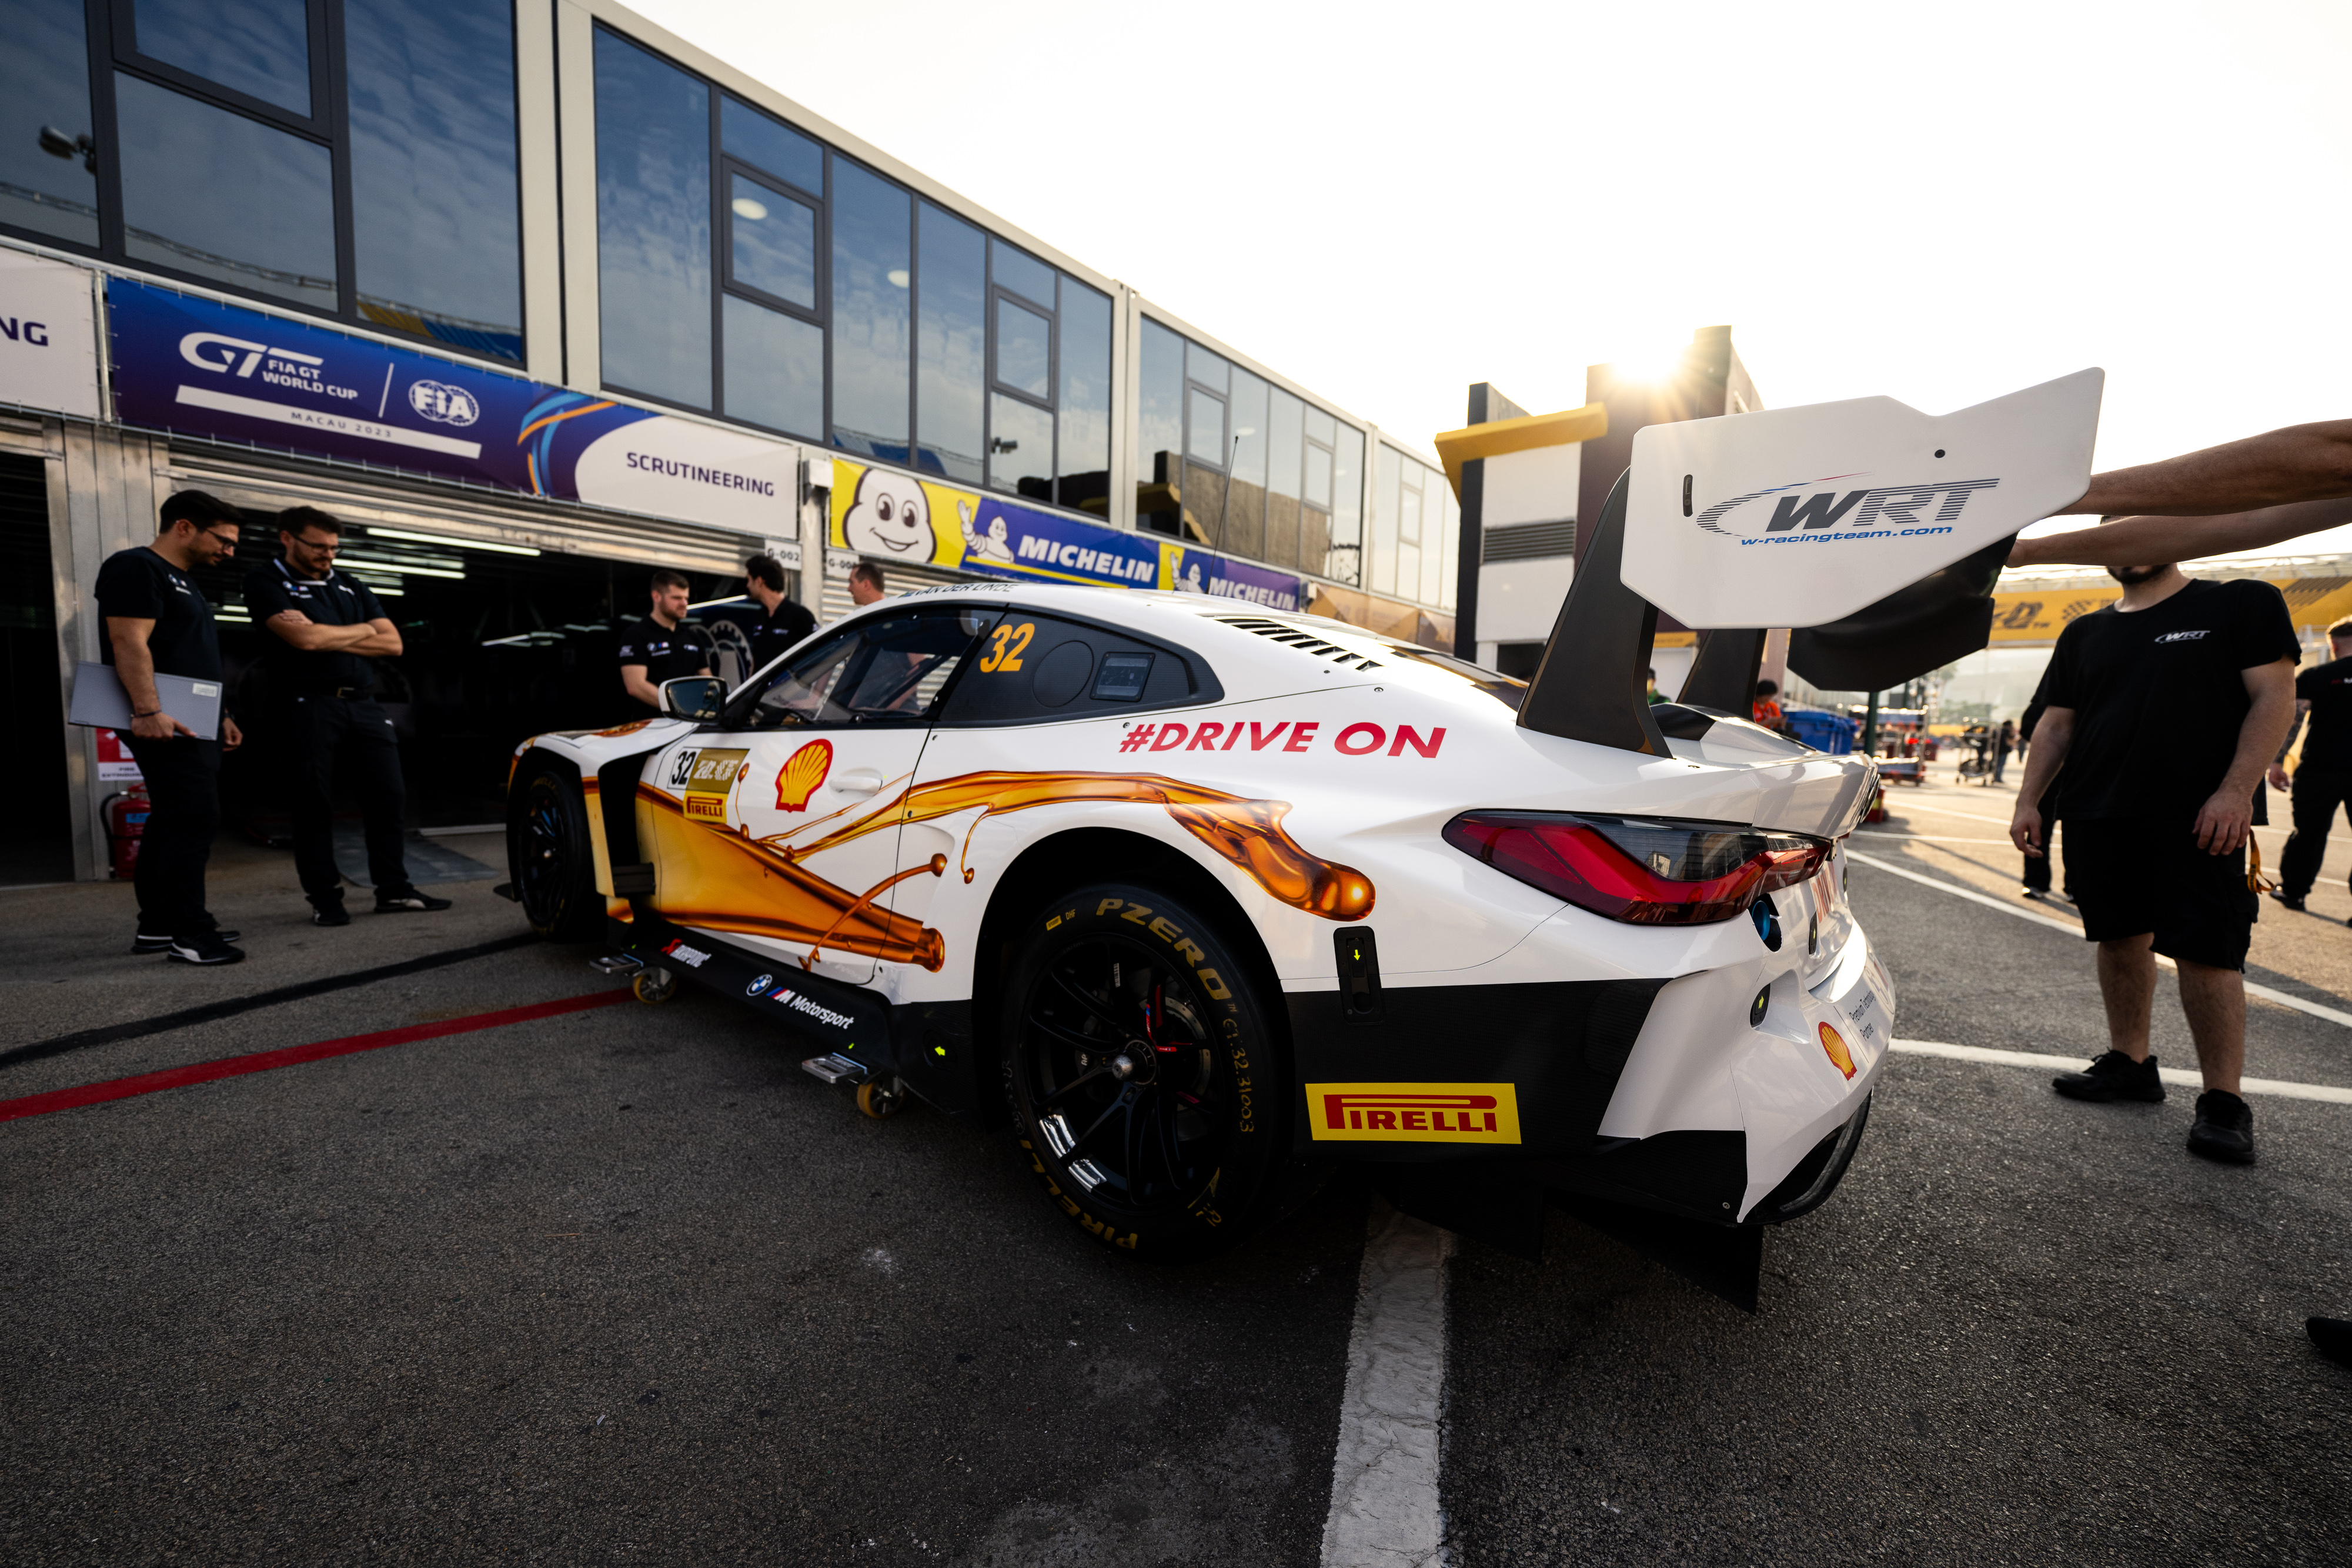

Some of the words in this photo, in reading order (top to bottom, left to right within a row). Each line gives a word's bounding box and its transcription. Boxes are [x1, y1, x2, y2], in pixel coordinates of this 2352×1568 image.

[179, 332, 268, 378] GT
[268, 359, 296, 375] FIA
[299, 366, 321, 380] GT
[262, 370, 324, 393] WORLD
[326, 385, 359, 400] CUP
[291, 412, 346, 430] MACAU
[355, 424, 391, 438] 2023
[626, 452, 774, 497] SCRUTINEERING
[1766, 478, 2000, 533] WRT
[1741, 526, 1953, 546] w-racingteam.com
[1017, 534, 1155, 583] MICHELIN
[942, 584, 973, 592] DER
[972, 583, 1018, 593] LINDE
[1208, 576, 1297, 611] MICHELIN
[980, 623, 1035, 673] 32
[2165, 630, 2211, 641] WRT
[1118, 721, 1319, 753] #DRIVE
[1334, 721, 1446, 758] ON
[671, 750, 697, 785] 32
[686, 795, 723, 817] PIRELLI
[1065, 908, 1076, 921] DHF
[789, 995, 854, 1029] Motorsport
[1849, 1002, 1866, 1024] Premium
[1859, 1022, 1875, 1041] Partner
[1323, 1094, 1498, 1133] PIRELLI
[1019, 1139, 1138, 1250] PIRELLI
